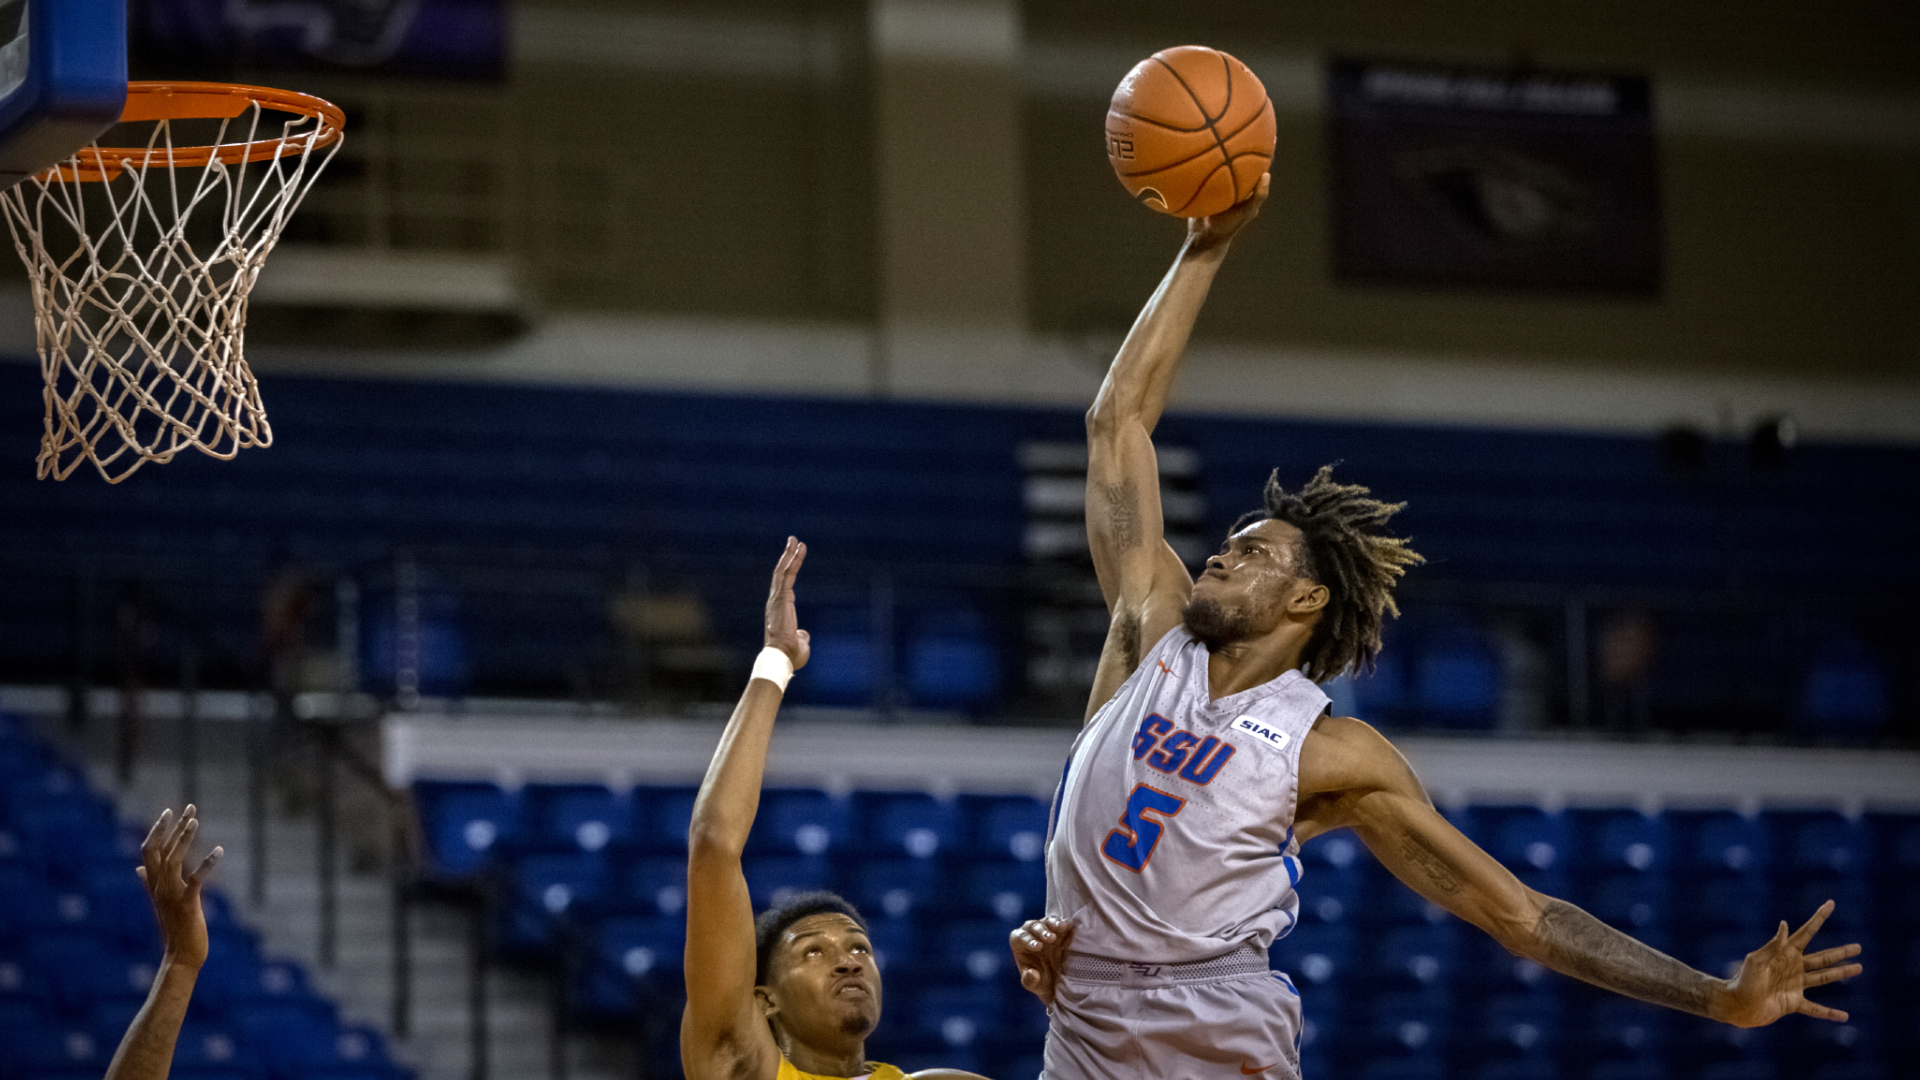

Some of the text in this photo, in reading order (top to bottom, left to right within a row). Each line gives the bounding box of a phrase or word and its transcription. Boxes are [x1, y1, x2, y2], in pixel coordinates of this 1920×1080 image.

[1132, 712, 1236, 786] SSU
[1239, 719, 1283, 744] SIAC
[1100, 782, 1187, 874] 5
